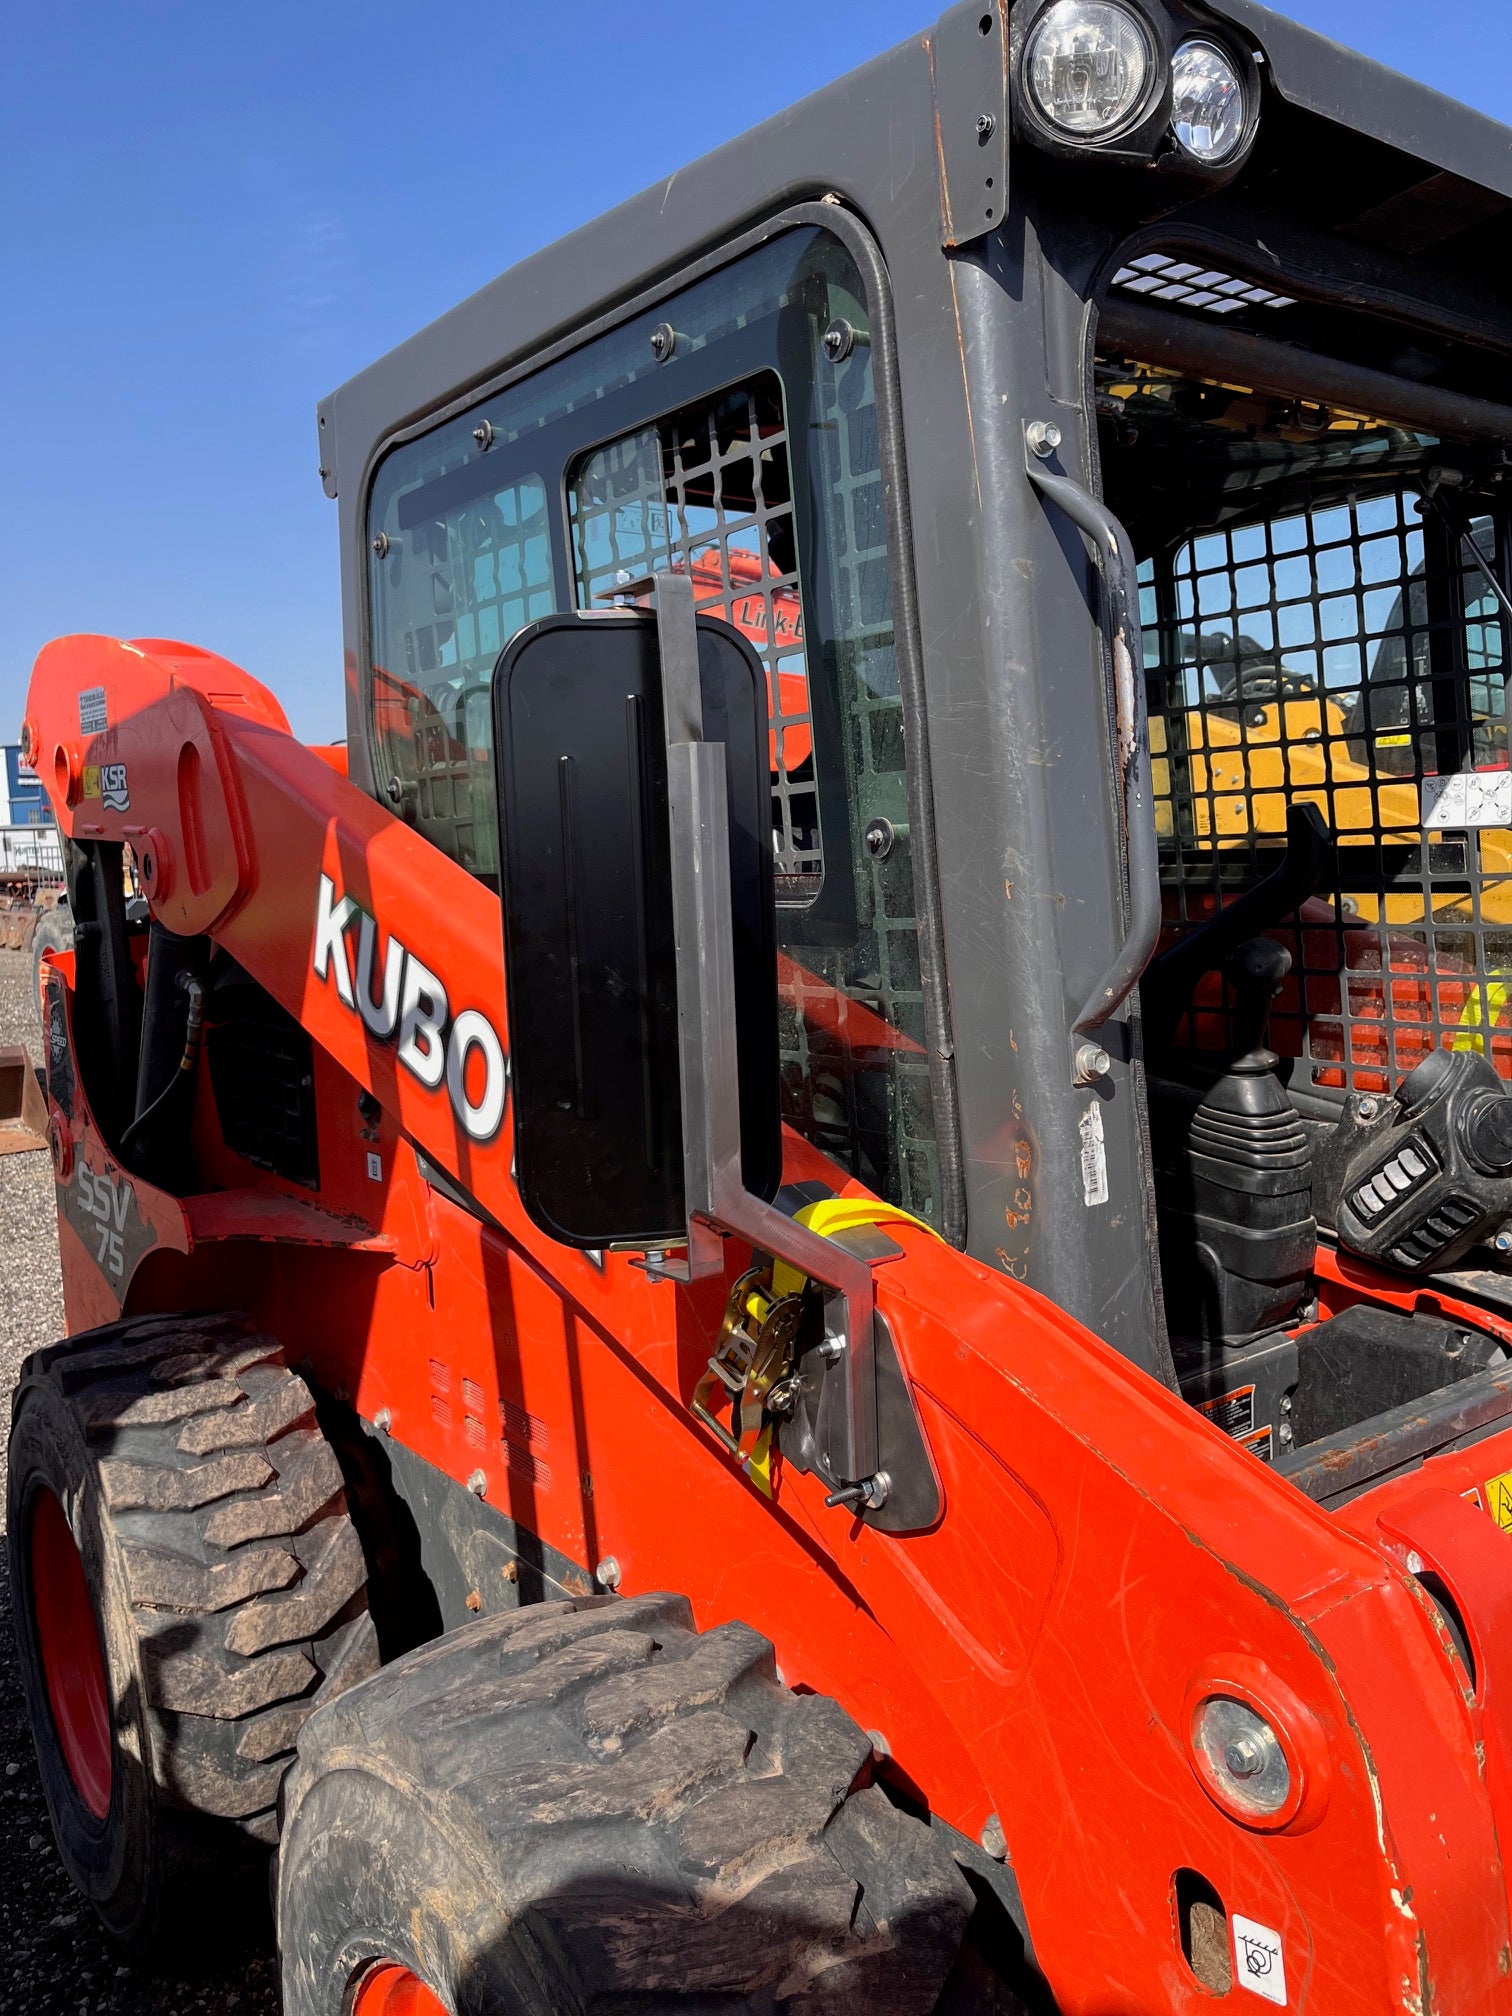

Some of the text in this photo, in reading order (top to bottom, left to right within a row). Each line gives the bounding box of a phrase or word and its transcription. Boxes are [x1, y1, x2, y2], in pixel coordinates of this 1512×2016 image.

[102, 765, 127, 791] KSR
[77, 1161, 131, 1233] SSV
[95, 1222, 124, 1277] 75
